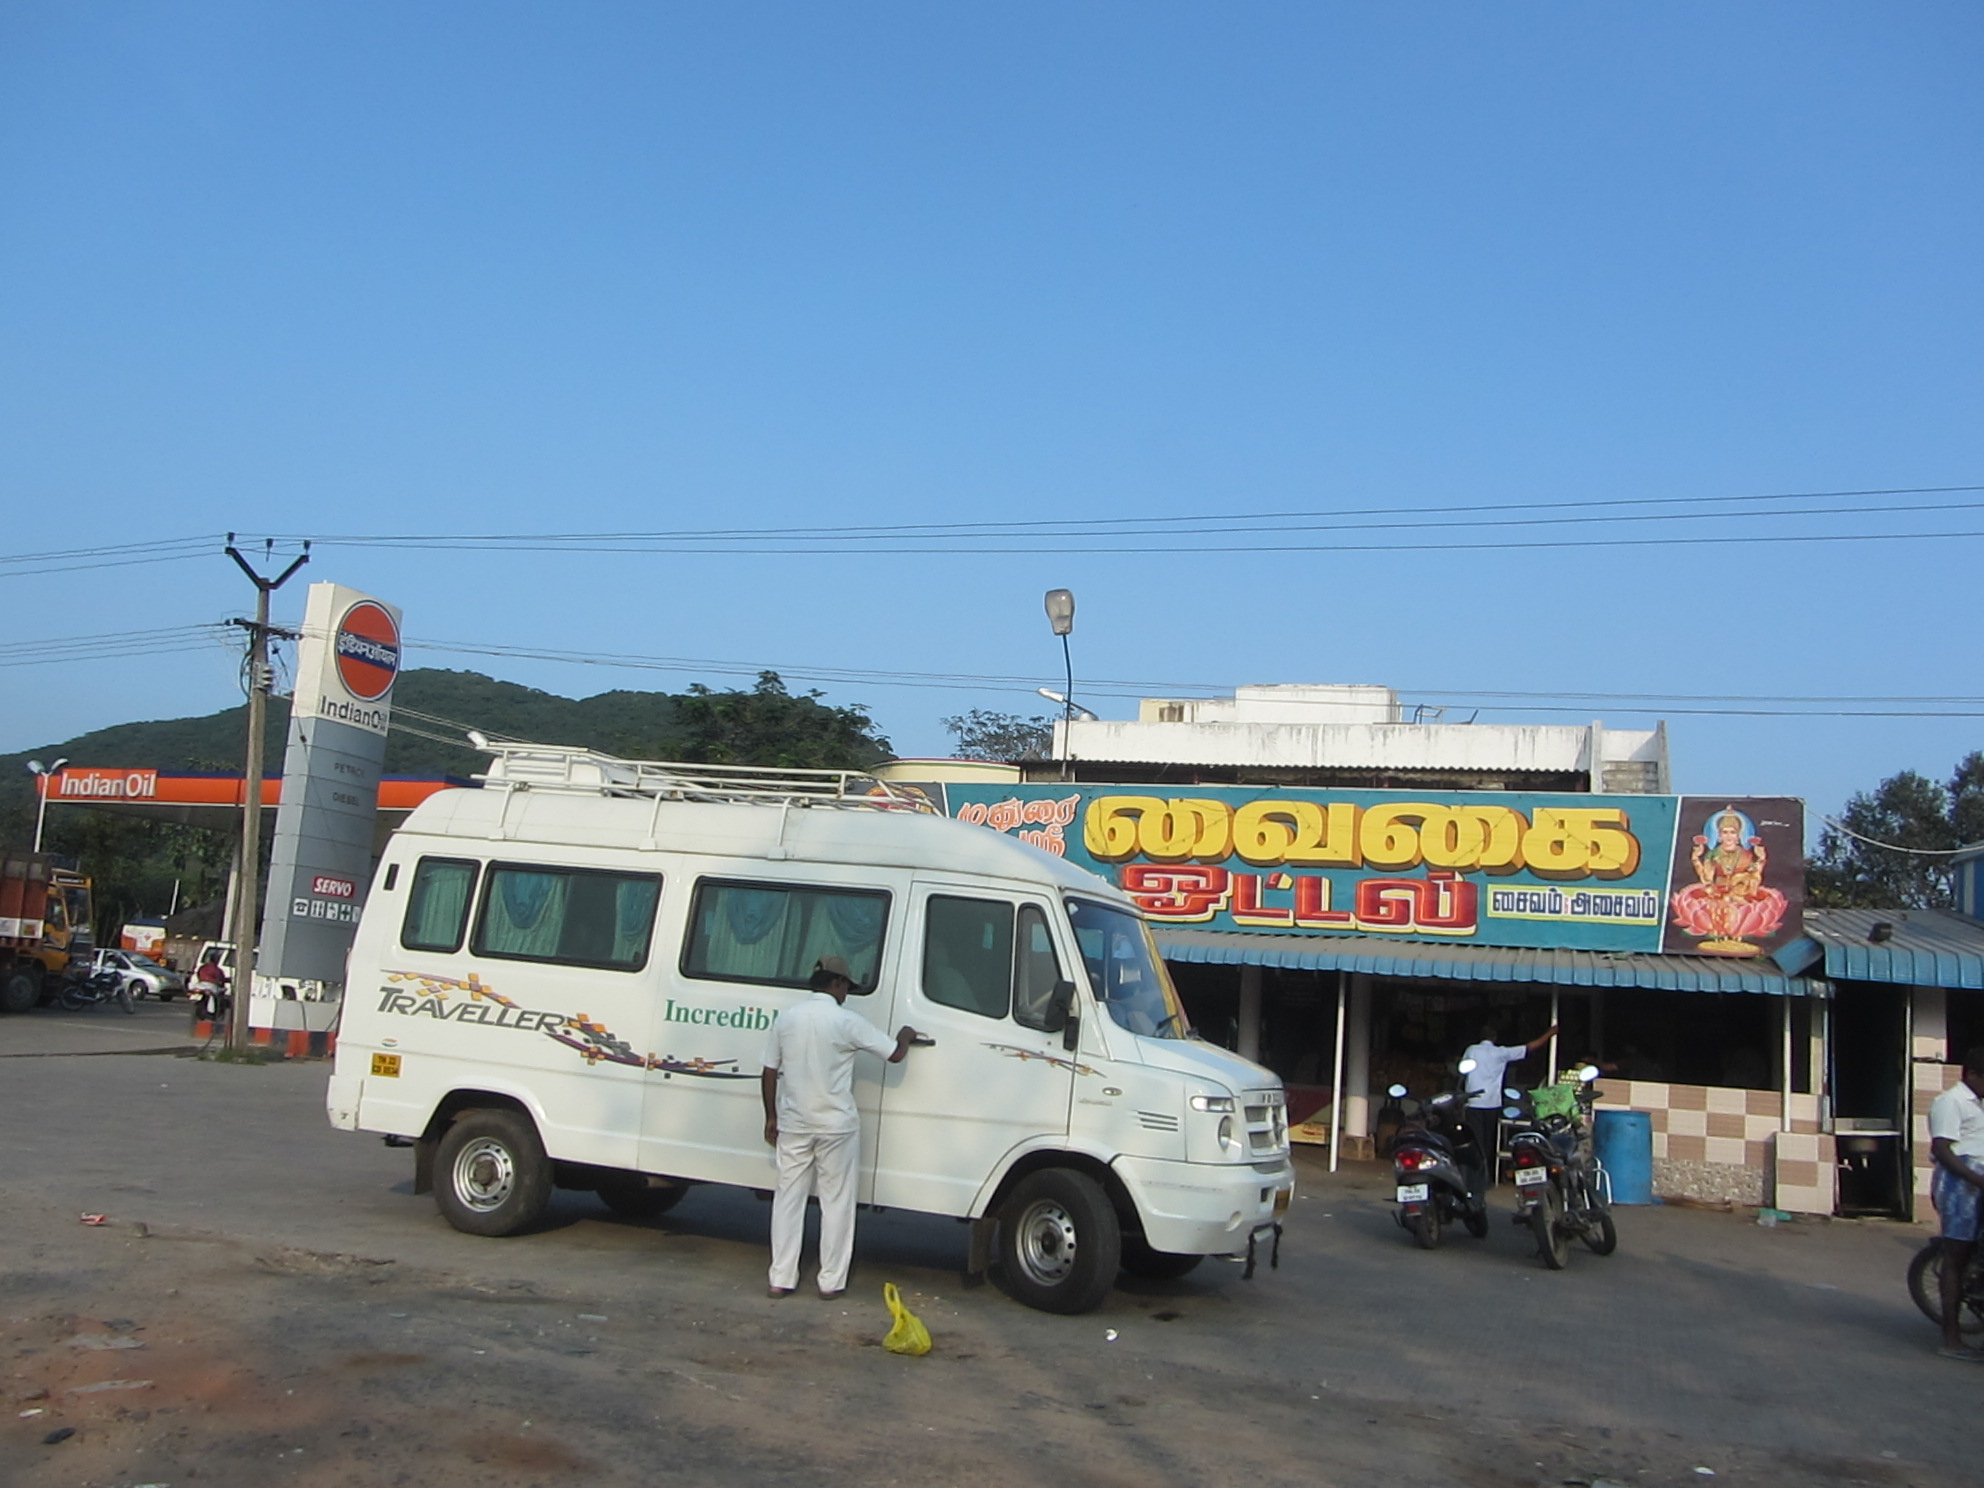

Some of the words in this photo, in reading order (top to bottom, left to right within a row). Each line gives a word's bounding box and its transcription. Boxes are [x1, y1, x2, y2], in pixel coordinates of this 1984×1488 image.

[61, 772, 157, 797] IndianOil
[332, 792, 360, 806] DIESEL
[957, 793, 1081, 832] மதுரை
[1083, 795, 1640, 879] வைகை
[314, 878, 352, 897] SERVO
[1493, 887, 1562, 914] சைவம்
[1571, 890, 1656, 918] அசைவம்
[376, 986, 566, 1033] TRAVELLER
